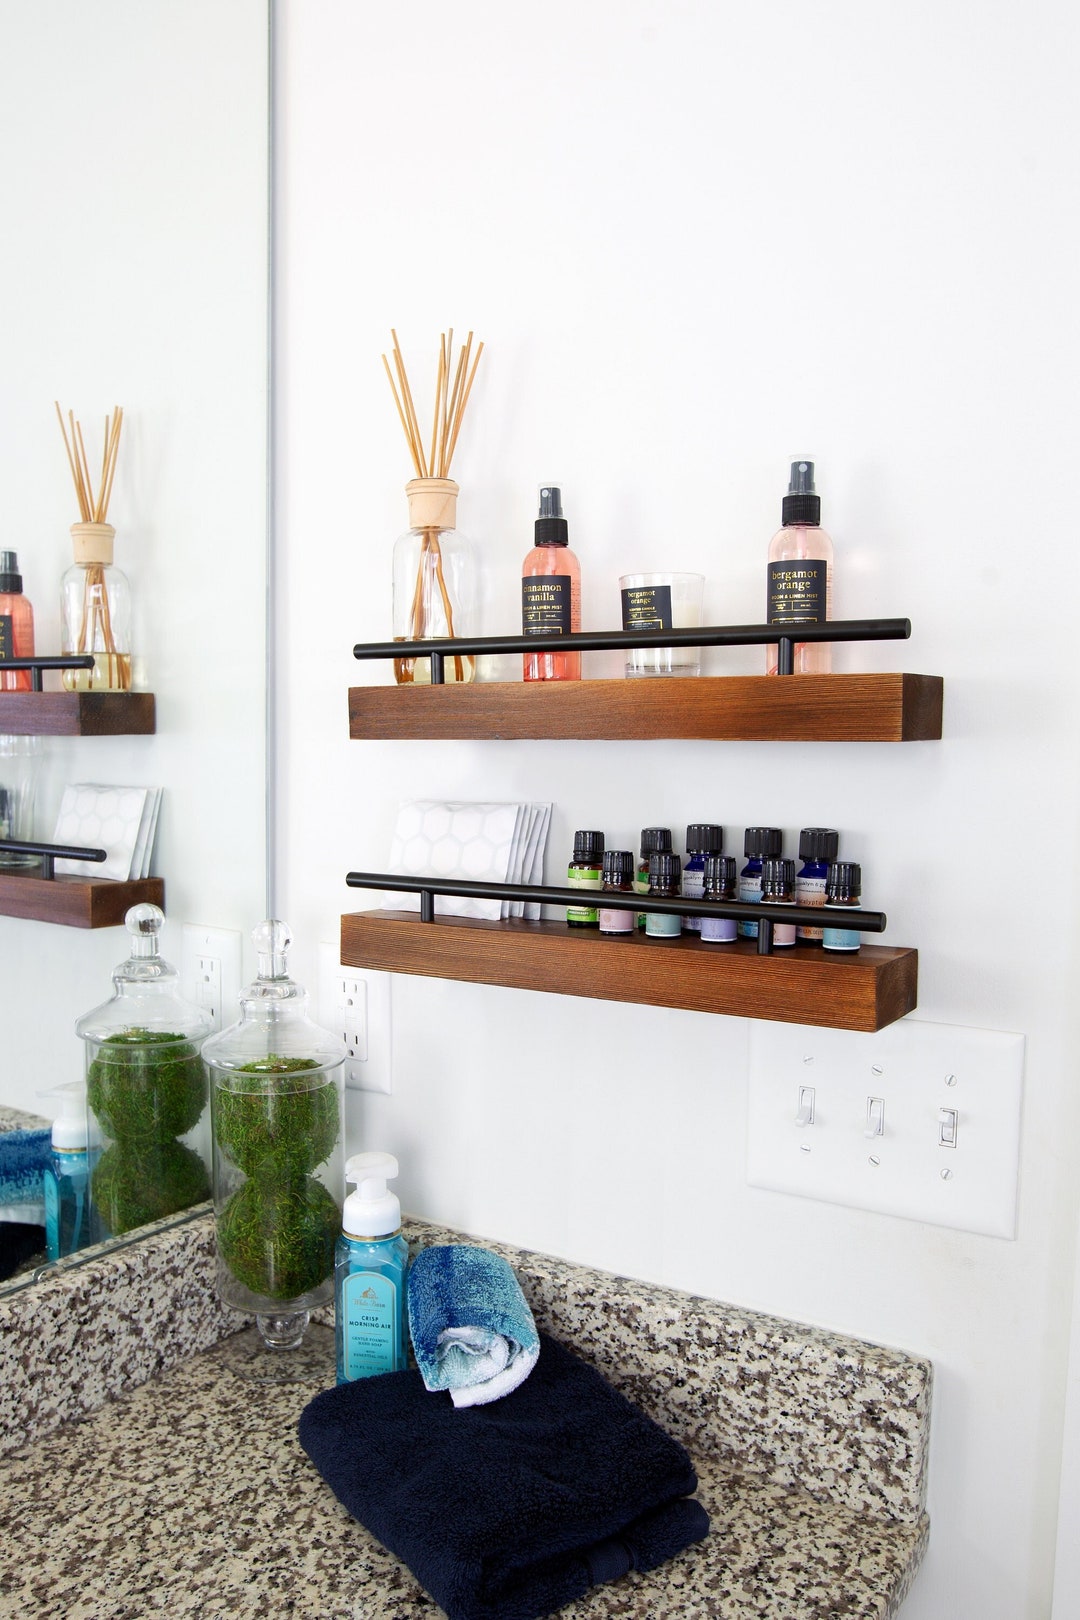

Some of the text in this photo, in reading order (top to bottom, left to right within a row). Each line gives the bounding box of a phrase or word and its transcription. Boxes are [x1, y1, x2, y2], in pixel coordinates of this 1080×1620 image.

[772, 570, 818, 581] bergamot
[776, 581, 811, 591] orange
[627, 590, 656, 598] bergamot
[349, 1320, 380, 1328] MORNING
